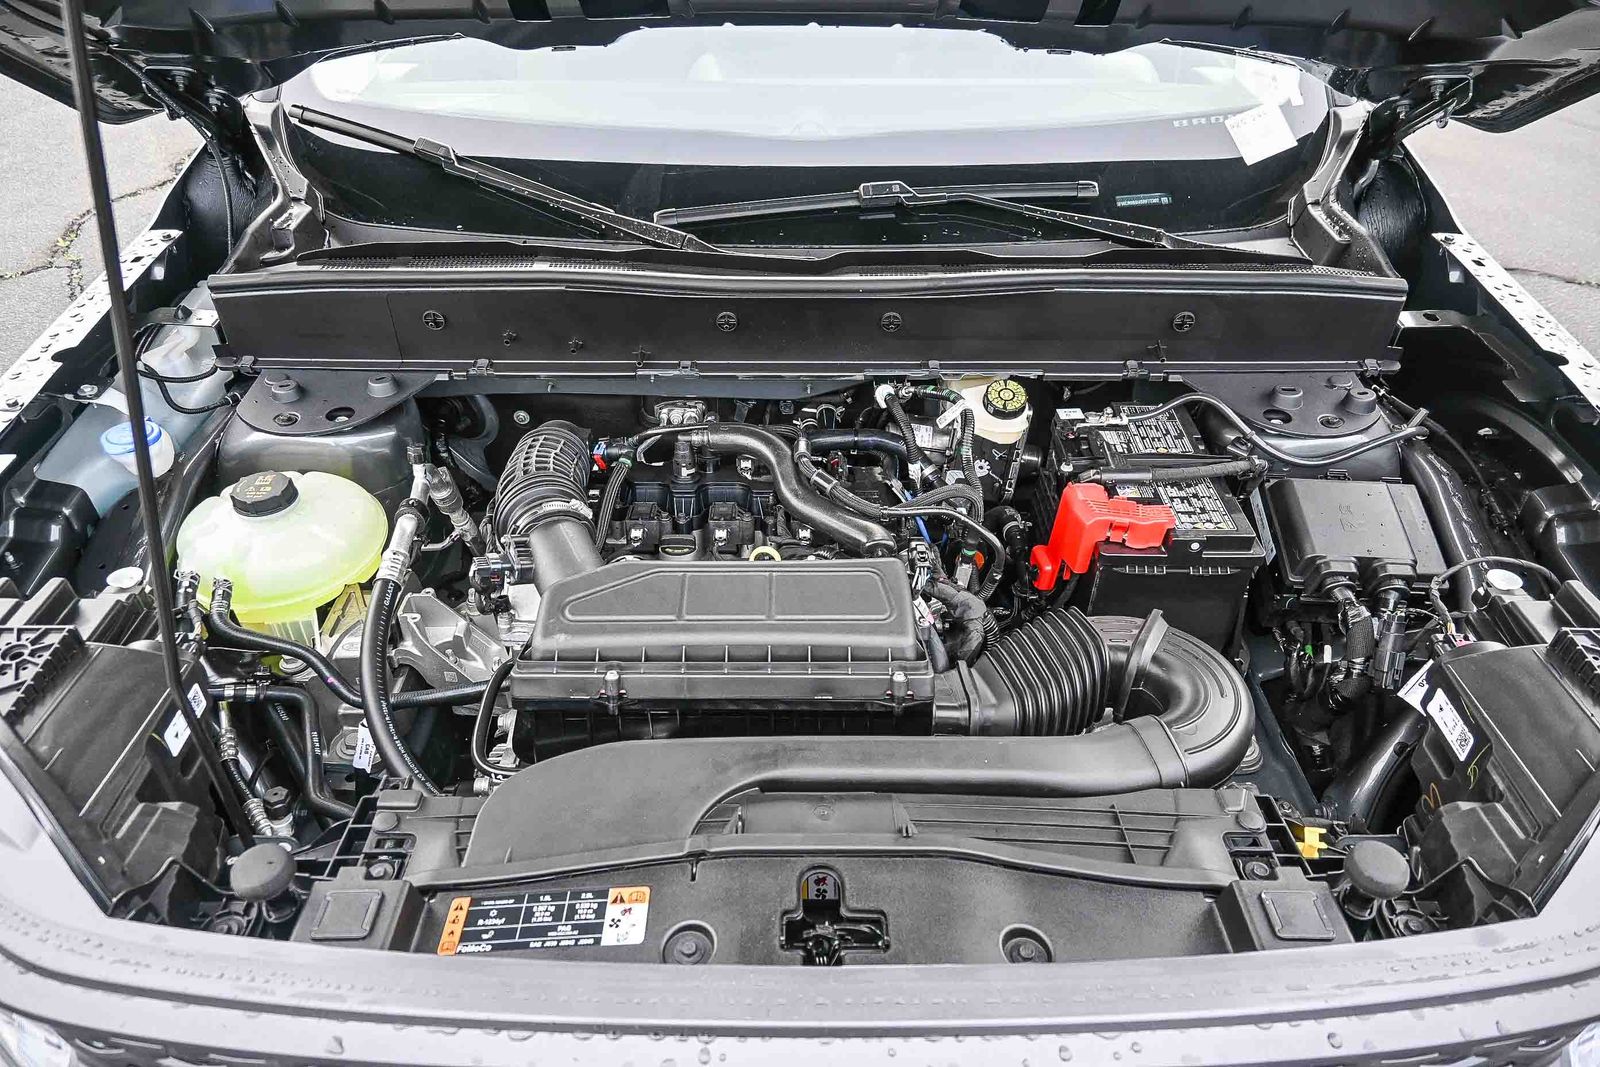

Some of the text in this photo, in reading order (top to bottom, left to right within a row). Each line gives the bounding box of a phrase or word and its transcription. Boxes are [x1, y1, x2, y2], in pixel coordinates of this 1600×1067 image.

[384, 581, 395, 605] GALAXY
[396, 740, 405, 753] HOSE
[403, 754, 419, 773] SUCTION
[456, 943, 492, 953] FoMoCo
